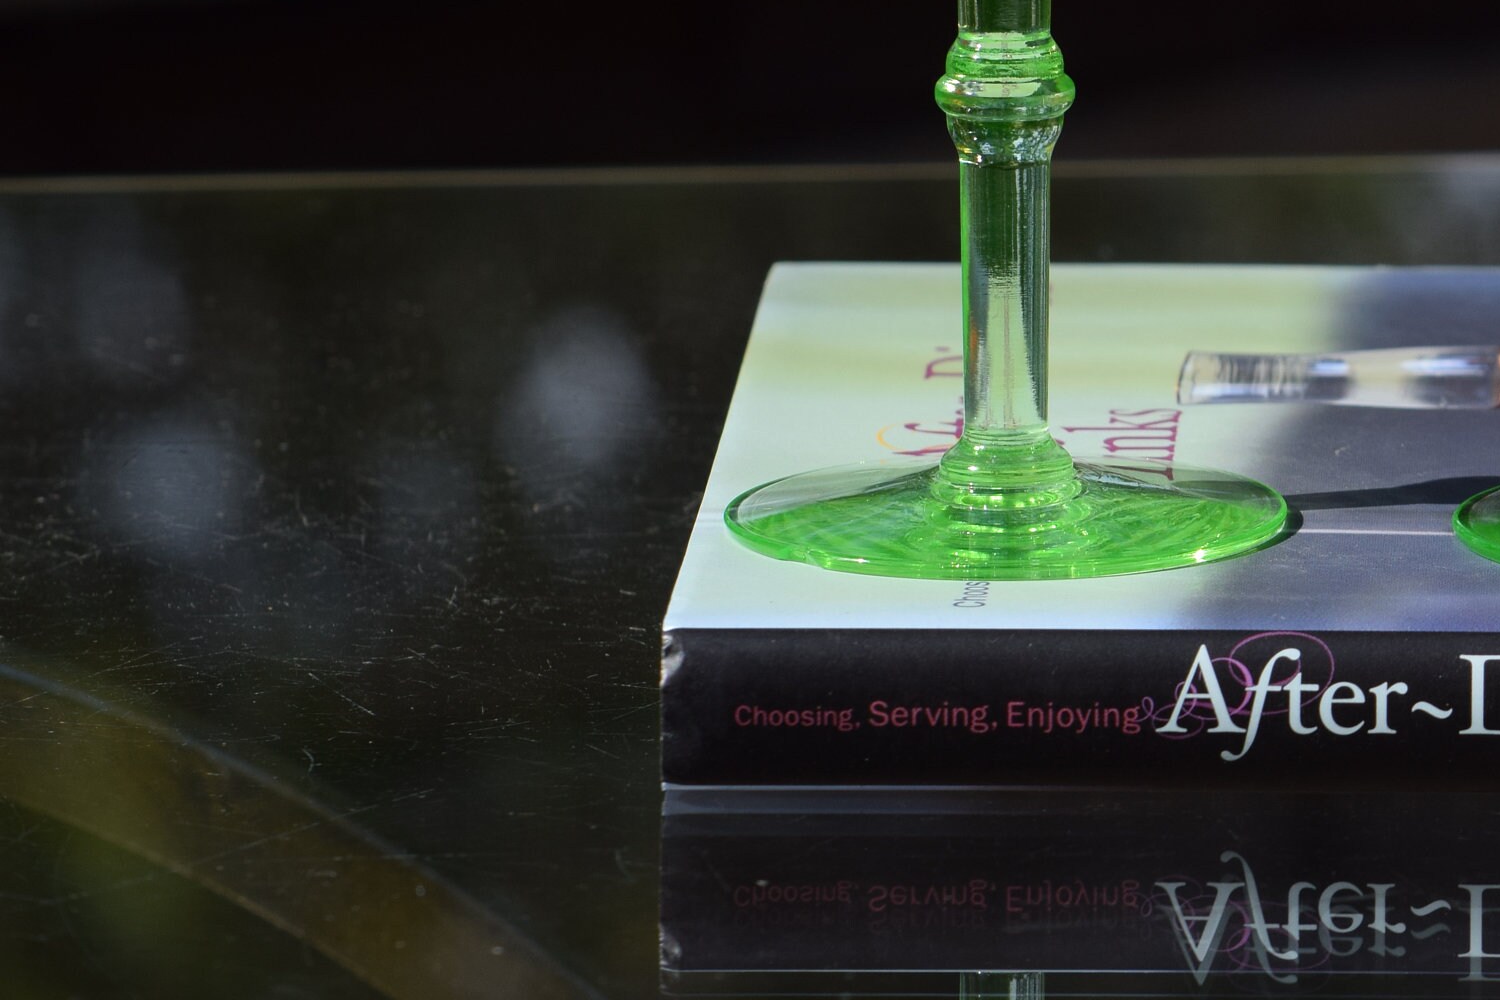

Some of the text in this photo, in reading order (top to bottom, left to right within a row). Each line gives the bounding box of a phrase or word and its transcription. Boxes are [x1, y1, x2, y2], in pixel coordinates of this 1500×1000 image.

[734, 700, 1142, 735] Choosing, Serving, Enjoying
